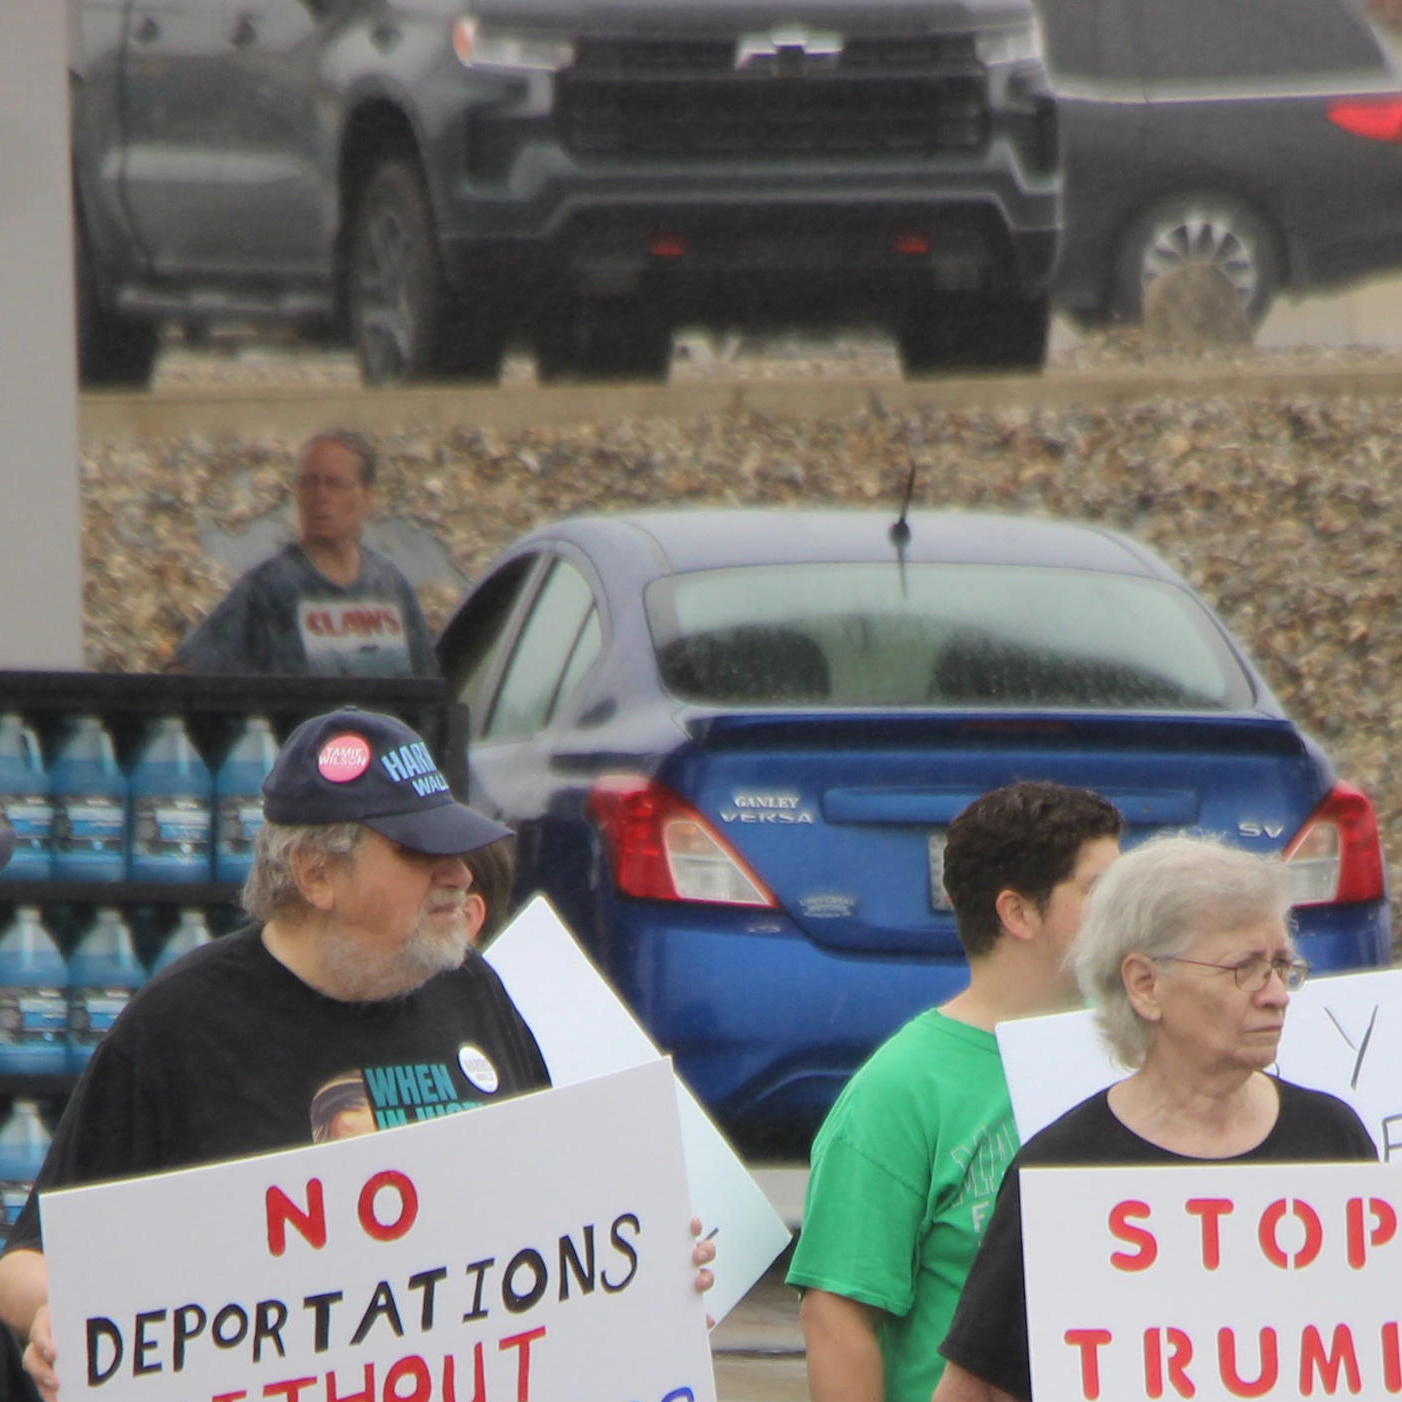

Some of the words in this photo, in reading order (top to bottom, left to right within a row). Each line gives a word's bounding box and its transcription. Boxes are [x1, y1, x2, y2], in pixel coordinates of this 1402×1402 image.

[326, 746, 364, 758] TAMIE
[318, 756, 367, 767] WILSON
[734, 795, 799, 809] GANLEY
[719, 812, 815, 825] VERSA
[1238, 823, 1284, 839] SV
[364, 1064, 458, 1108] WHEN
[265, 1169, 419, 1257] NO
[1108, 1197, 1398, 1273] STOP
[86, 1213, 641, 1386] DEPORTATIONS
